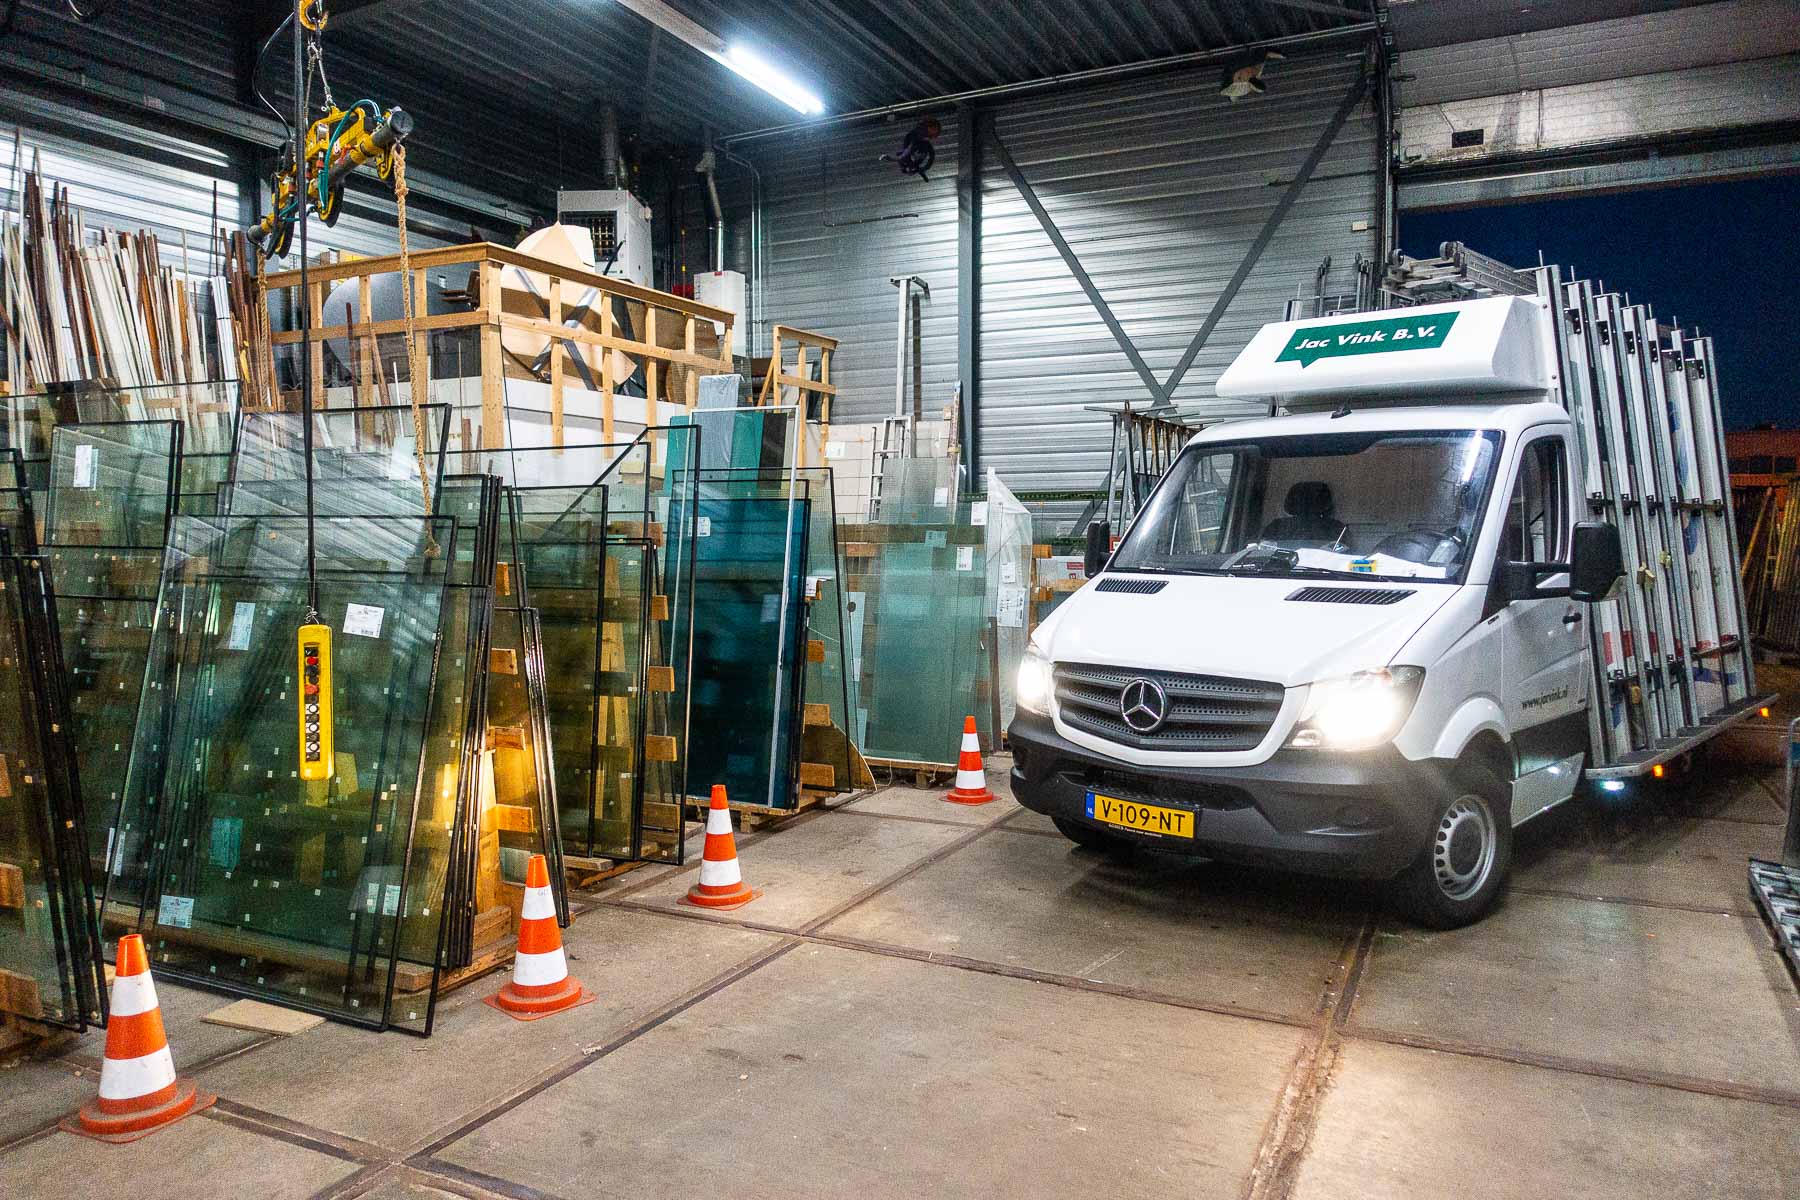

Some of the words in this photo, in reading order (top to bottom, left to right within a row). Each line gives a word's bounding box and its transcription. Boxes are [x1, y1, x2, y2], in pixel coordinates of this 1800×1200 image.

[1295, 337, 1330, 350] Jac
[1337, 330, 1388, 347] Vink
[1392, 325, 1436, 341] B.V.
[1102, 799, 1185, 832] V-109-NT
